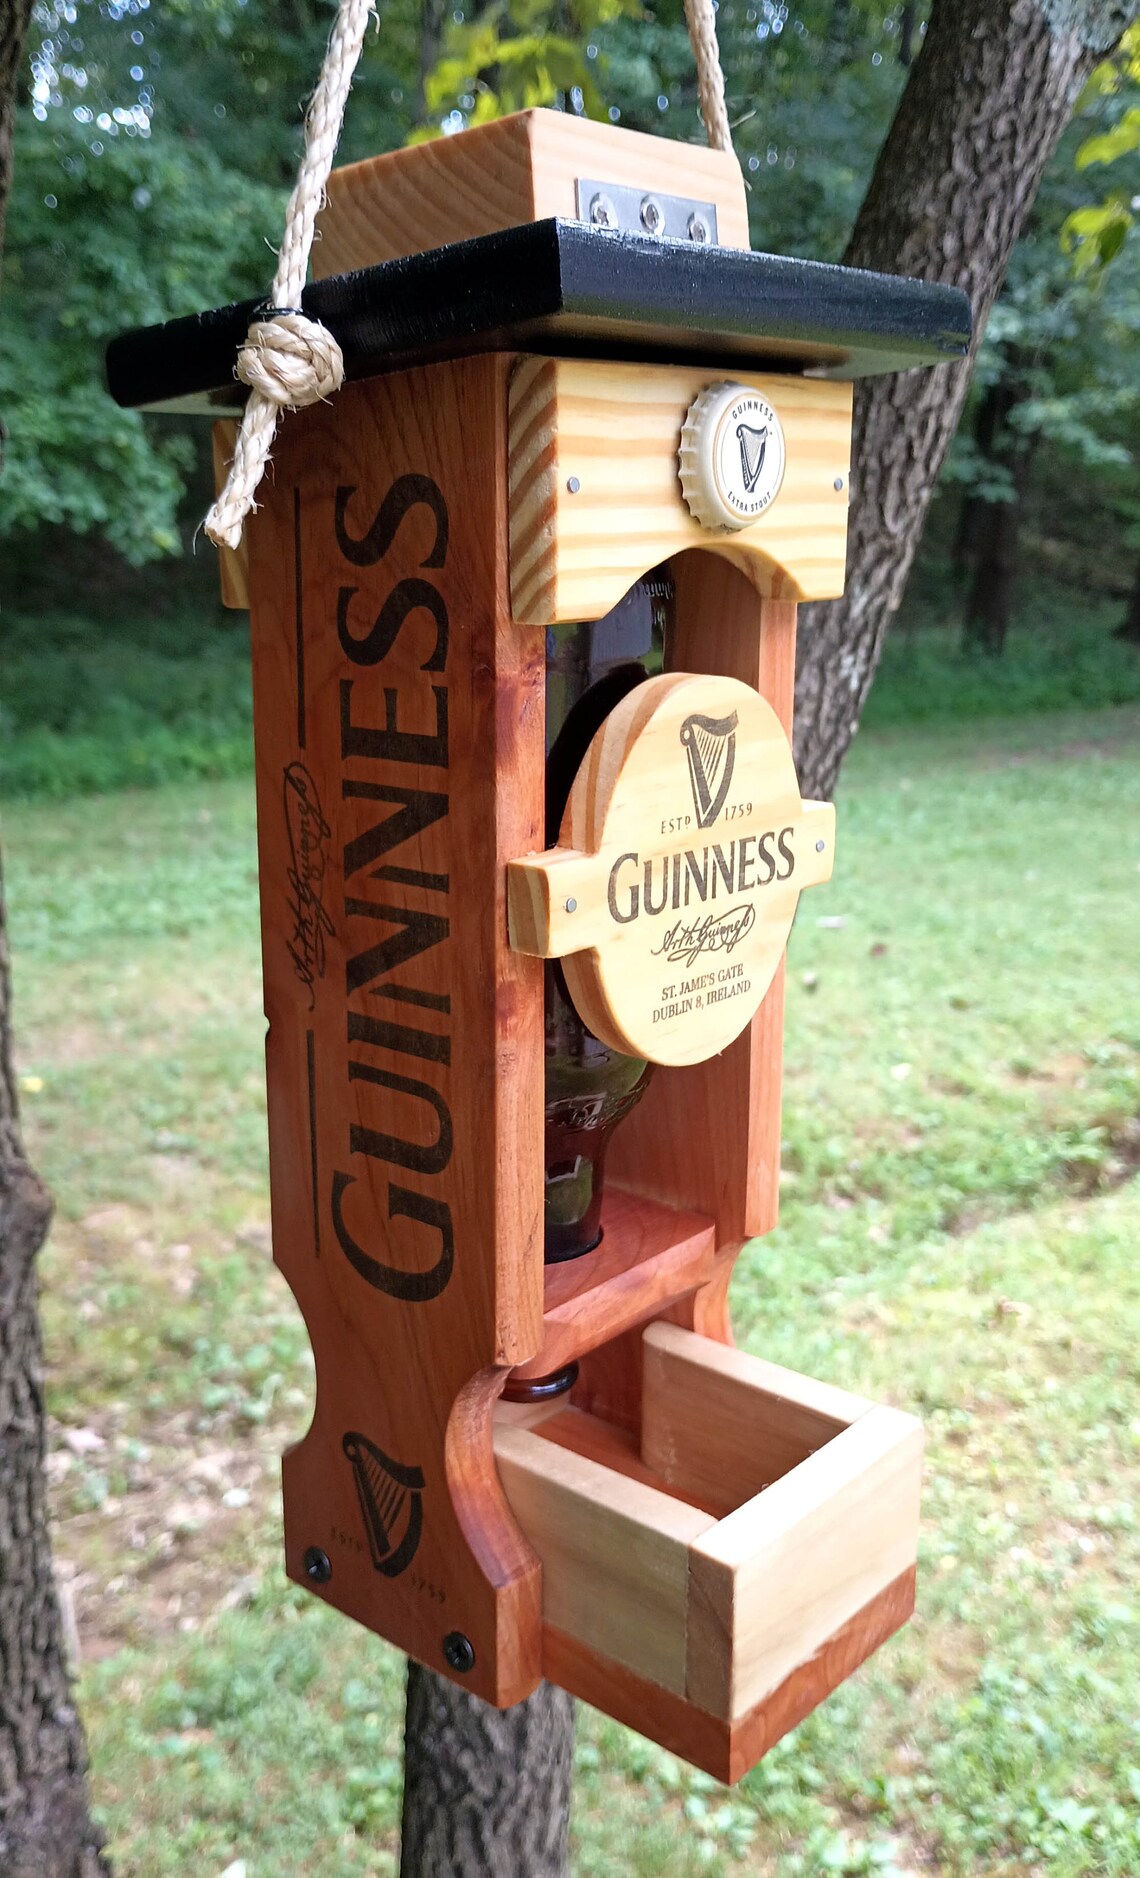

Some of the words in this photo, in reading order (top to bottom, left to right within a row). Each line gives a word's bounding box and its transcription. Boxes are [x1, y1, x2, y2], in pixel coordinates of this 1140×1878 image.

[732, 400, 774, 422] GUINNESS
[727, 490, 748, 513] EXTRA
[750, 491, 772, 513] STOUT
[725, 802, 753, 821] 1759
[331, 473, 455, 1303] GUINNESS
[607, 827, 796, 924] GUINNESS
[652, 998, 693, 1023] DUBLIN
[706, 979, 751, 1006] IRELAND
[661, 985, 678, 1001] ST.
[679, 972, 716, 996] JAME'S
[717, 963, 744, 983] GATE
